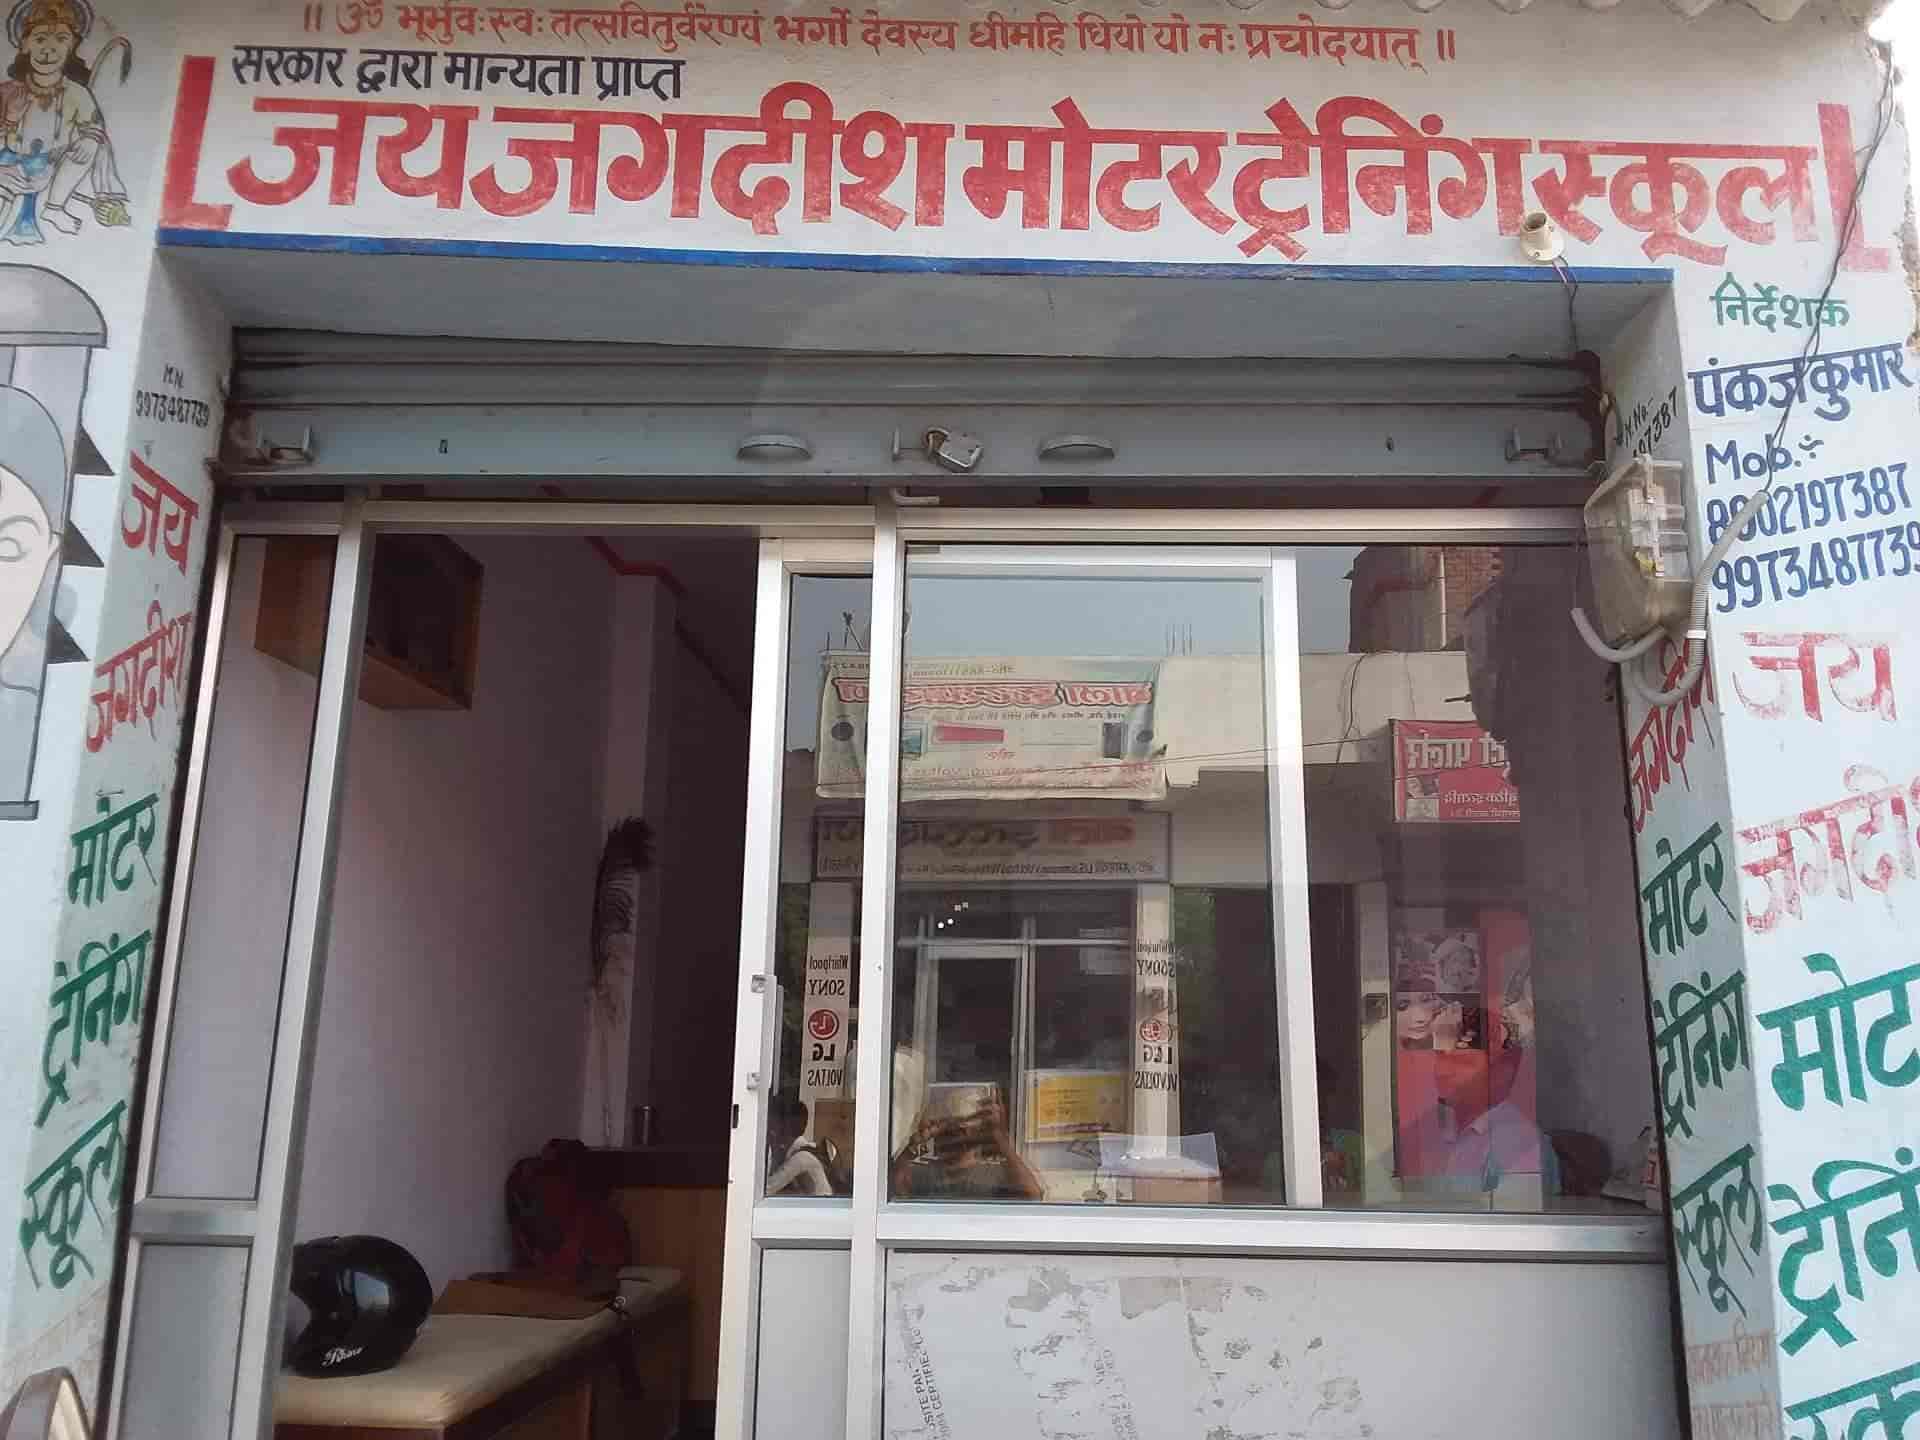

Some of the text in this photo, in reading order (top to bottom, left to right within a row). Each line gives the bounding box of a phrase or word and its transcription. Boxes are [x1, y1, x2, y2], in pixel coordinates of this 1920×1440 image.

[231, 45, 686, 101] सरकार द्वारा मान्यता प्राप्त
[773, 6, 852, 47] भर्गो
[860, 9, 958, 55] देवस्य
[968, 10, 1069, 56] धीमहि
[1151, 13, 1191, 53] यो
[226, 96, 480, 210] जय
[469, 80, 955, 236] जगदीश
[961, 95, 1237, 237] मोटर
[1532, 138, 1818, 267] स्कूल
[1709, 271, 1850, 333] निर्देशक
[1806, 342, 1914, 422] कुमार
[121, 449, 200, 576] जय
[86, 598, 194, 754] जगदीश
[1732, 630, 1902, 723] जय
[67, 790, 163, 909] मोटर
[1641, 820, 1738, 956] मोटर
[1737, 763, 1920, 934] जगदी
[1756, 952, 1920, 1112] मोट
[19, 1099, 128, 1290] स्कूल
[1672, 1143, 1764, 1320] स्कूल
[1766, 1145, 1920, 1357] ट्रेनिं
